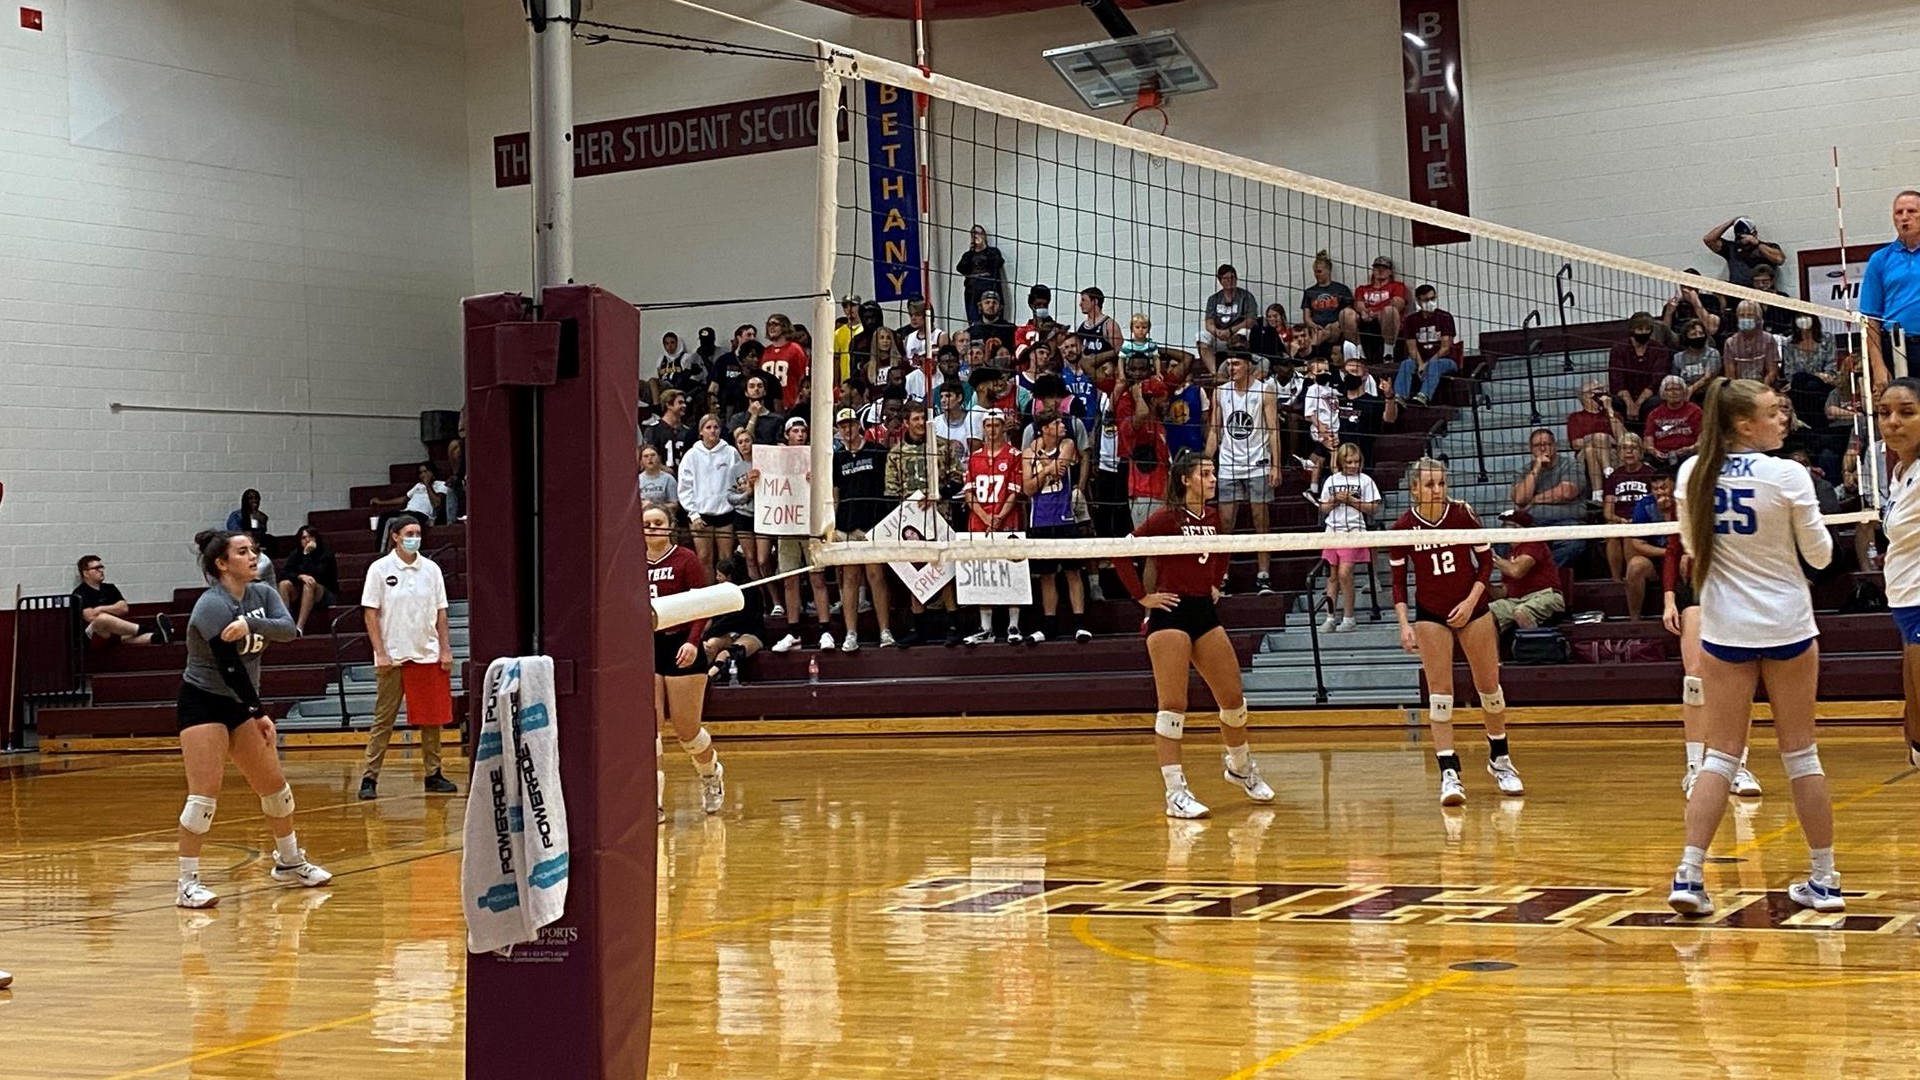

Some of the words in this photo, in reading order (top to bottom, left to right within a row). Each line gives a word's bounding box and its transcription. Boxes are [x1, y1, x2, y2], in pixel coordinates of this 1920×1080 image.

[622, 113, 732, 162] STUDENT
[739, 101, 844, 146] SECTIO
[879, 84, 908, 295] BETHANY
[1719, 456, 1758, 477] ORK
[763, 478, 792, 497] MIA
[975, 475, 1005, 503] 87
[762, 505, 806, 526] ZONE
[883, 503, 915, 538] JUST
[1713, 488, 1758, 534] 25
[1431, 551, 1456, 575] 12
[914, 564, 946, 597] SPIKE
[520, 742, 553, 849] POWERADE
[490, 766, 515, 875] POWERADE
[537, 927, 578, 941] PORTS
